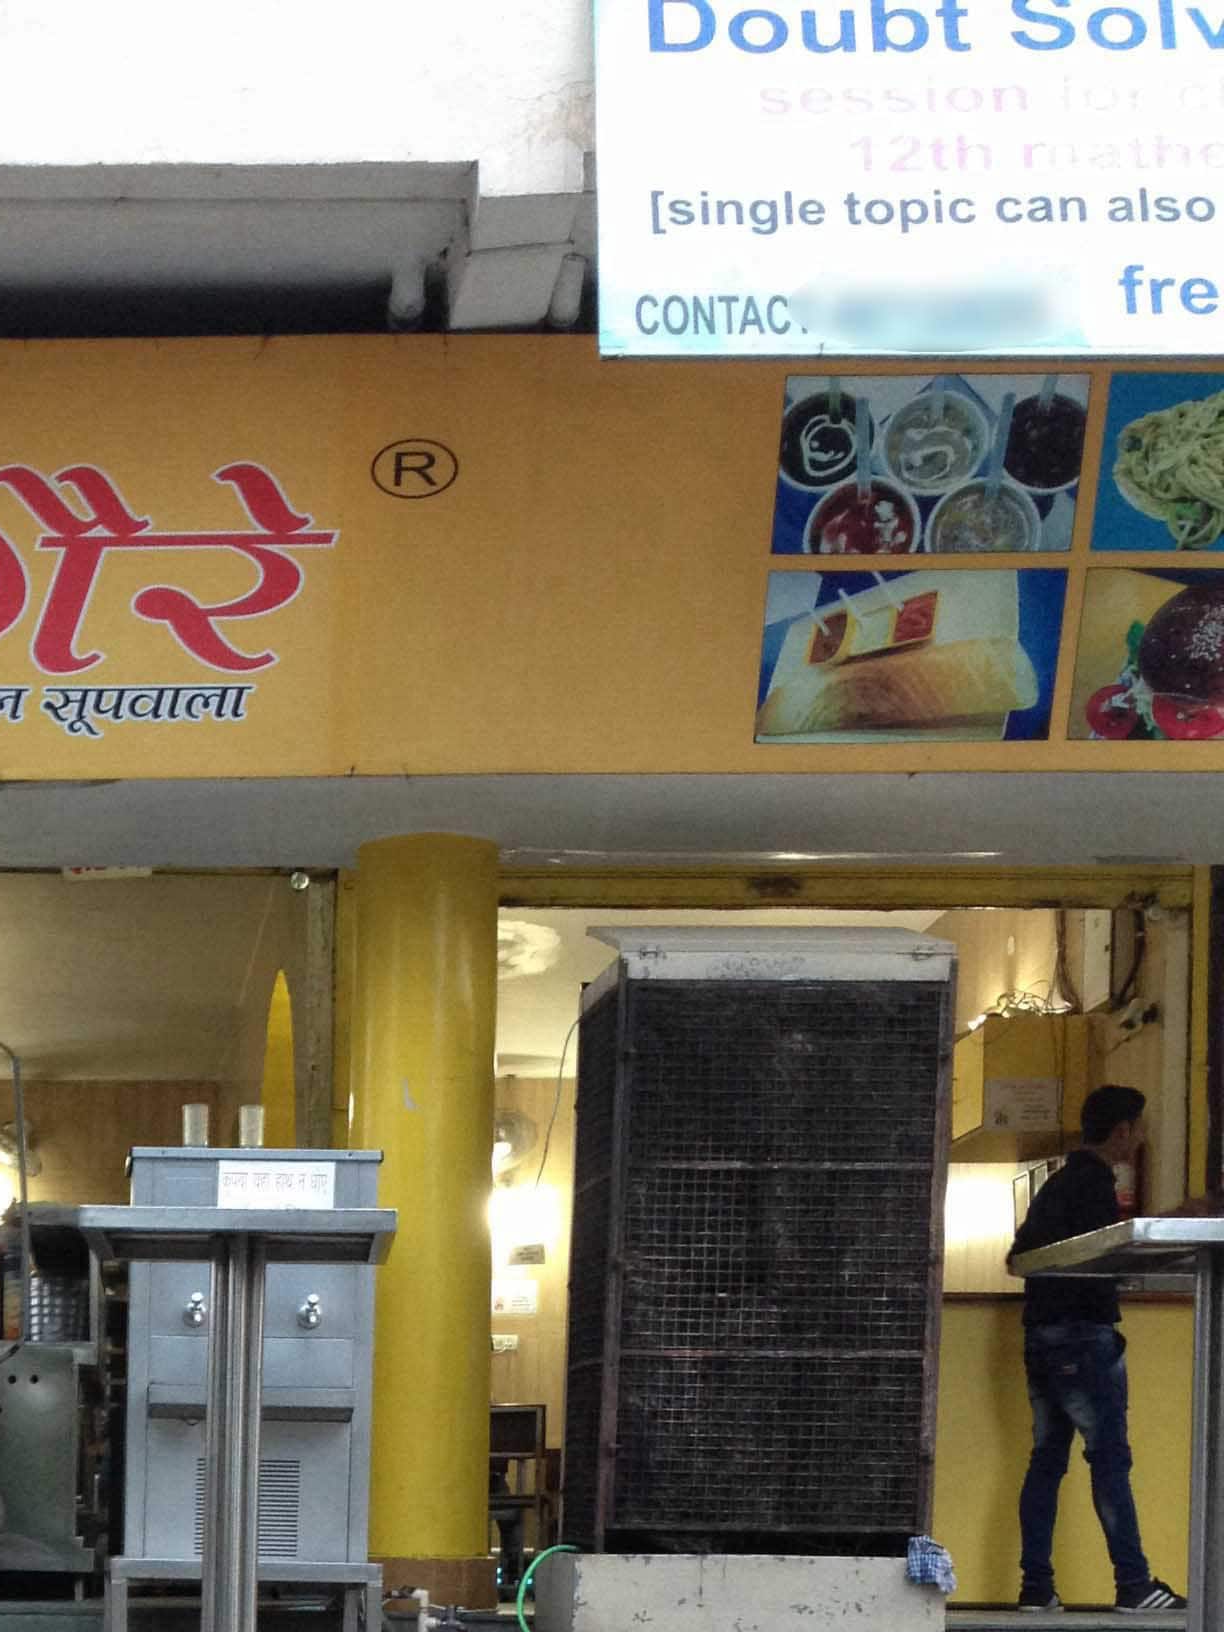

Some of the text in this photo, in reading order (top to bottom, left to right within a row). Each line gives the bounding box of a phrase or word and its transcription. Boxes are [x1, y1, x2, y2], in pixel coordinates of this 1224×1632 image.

[648, 0, 1224, 53] Doubt Solv
[759, 72, 1030, 114] session
[849, 134, 994, 171] 12th
[651, 187, 1216, 234] [single topic can also
[635, 294, 808, 336] CONTAC
[42, 683, 255, 736] सूपवाला
